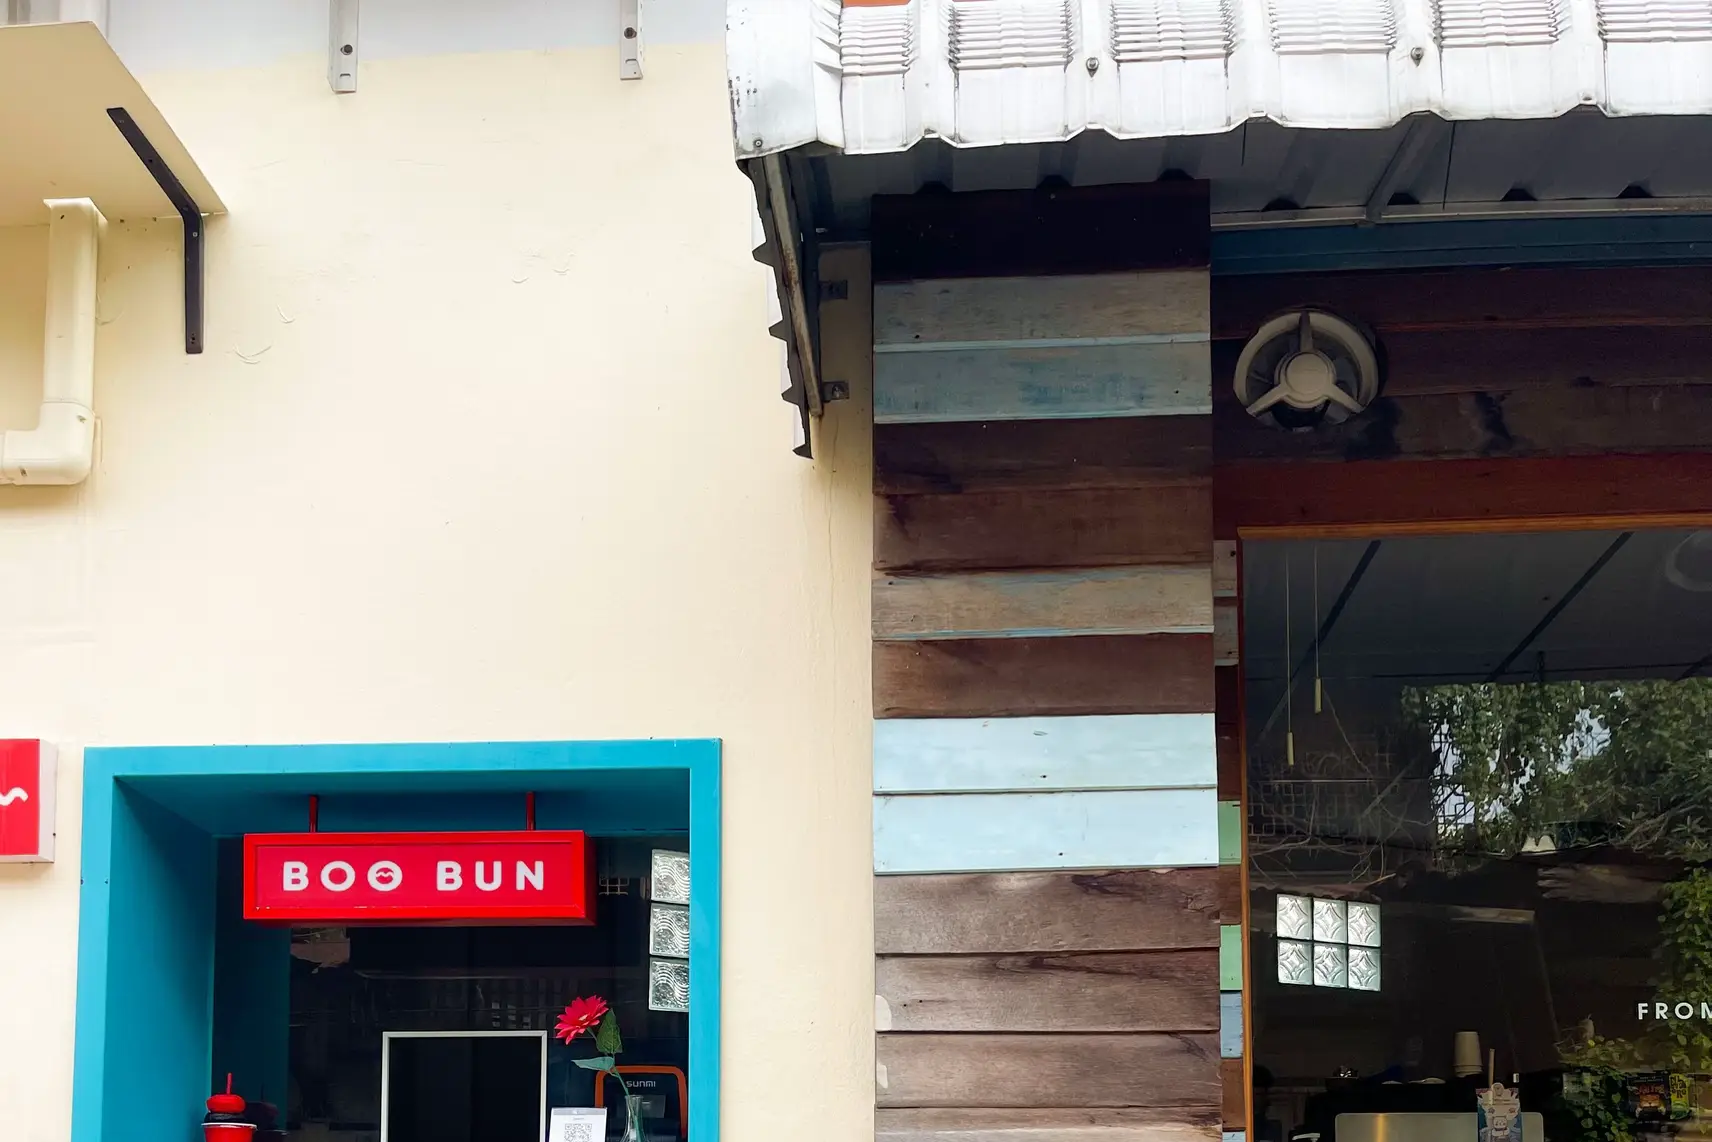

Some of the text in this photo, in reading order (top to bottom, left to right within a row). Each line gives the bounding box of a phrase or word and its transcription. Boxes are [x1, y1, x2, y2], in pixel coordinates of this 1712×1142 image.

[282, 860, 545, 892] BOO BUN
[1637, 1002, 1712, 1020] FROM
